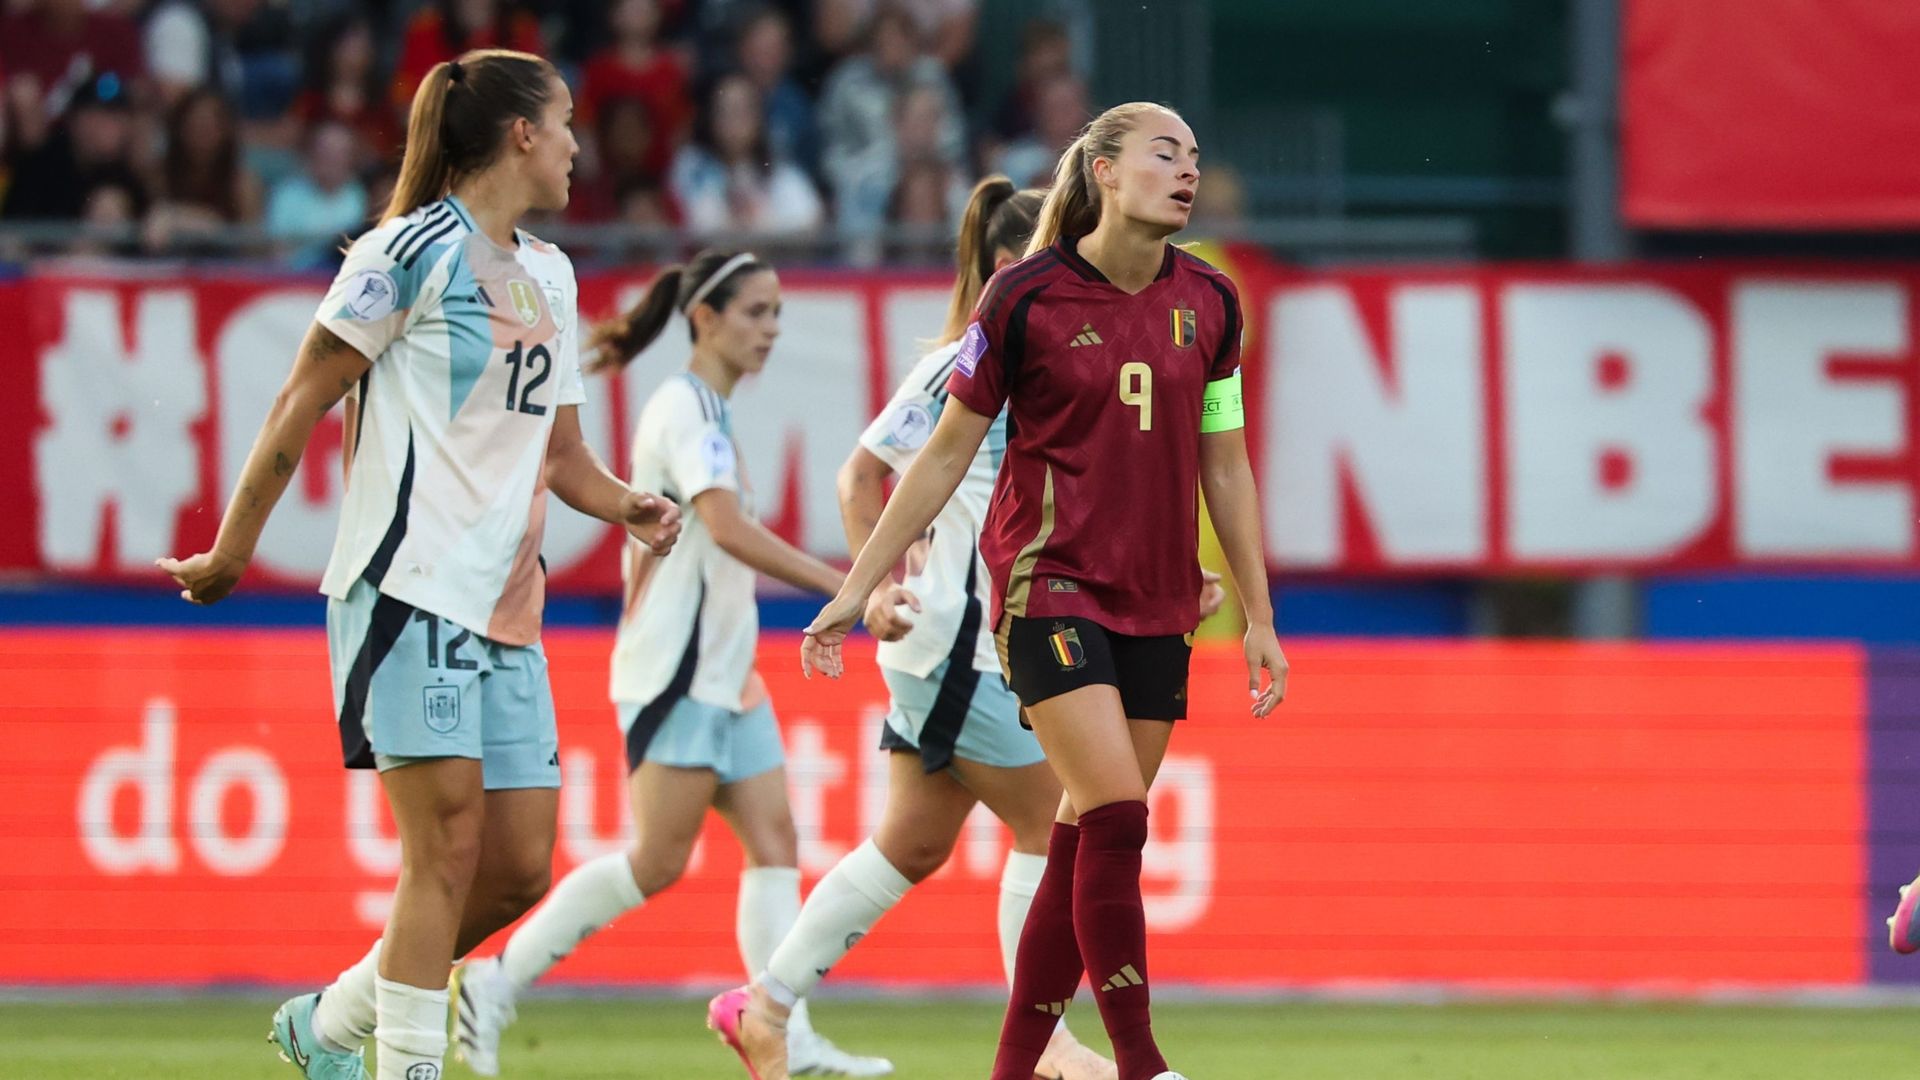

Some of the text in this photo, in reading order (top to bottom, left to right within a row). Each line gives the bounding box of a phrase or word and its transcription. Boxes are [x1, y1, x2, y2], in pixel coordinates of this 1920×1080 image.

[505, 340, 552, 416] 12
[1120, 362, 1151, 431] 9
[415, 612, 479, 670] 12
[78, 698, 289, 875] do
